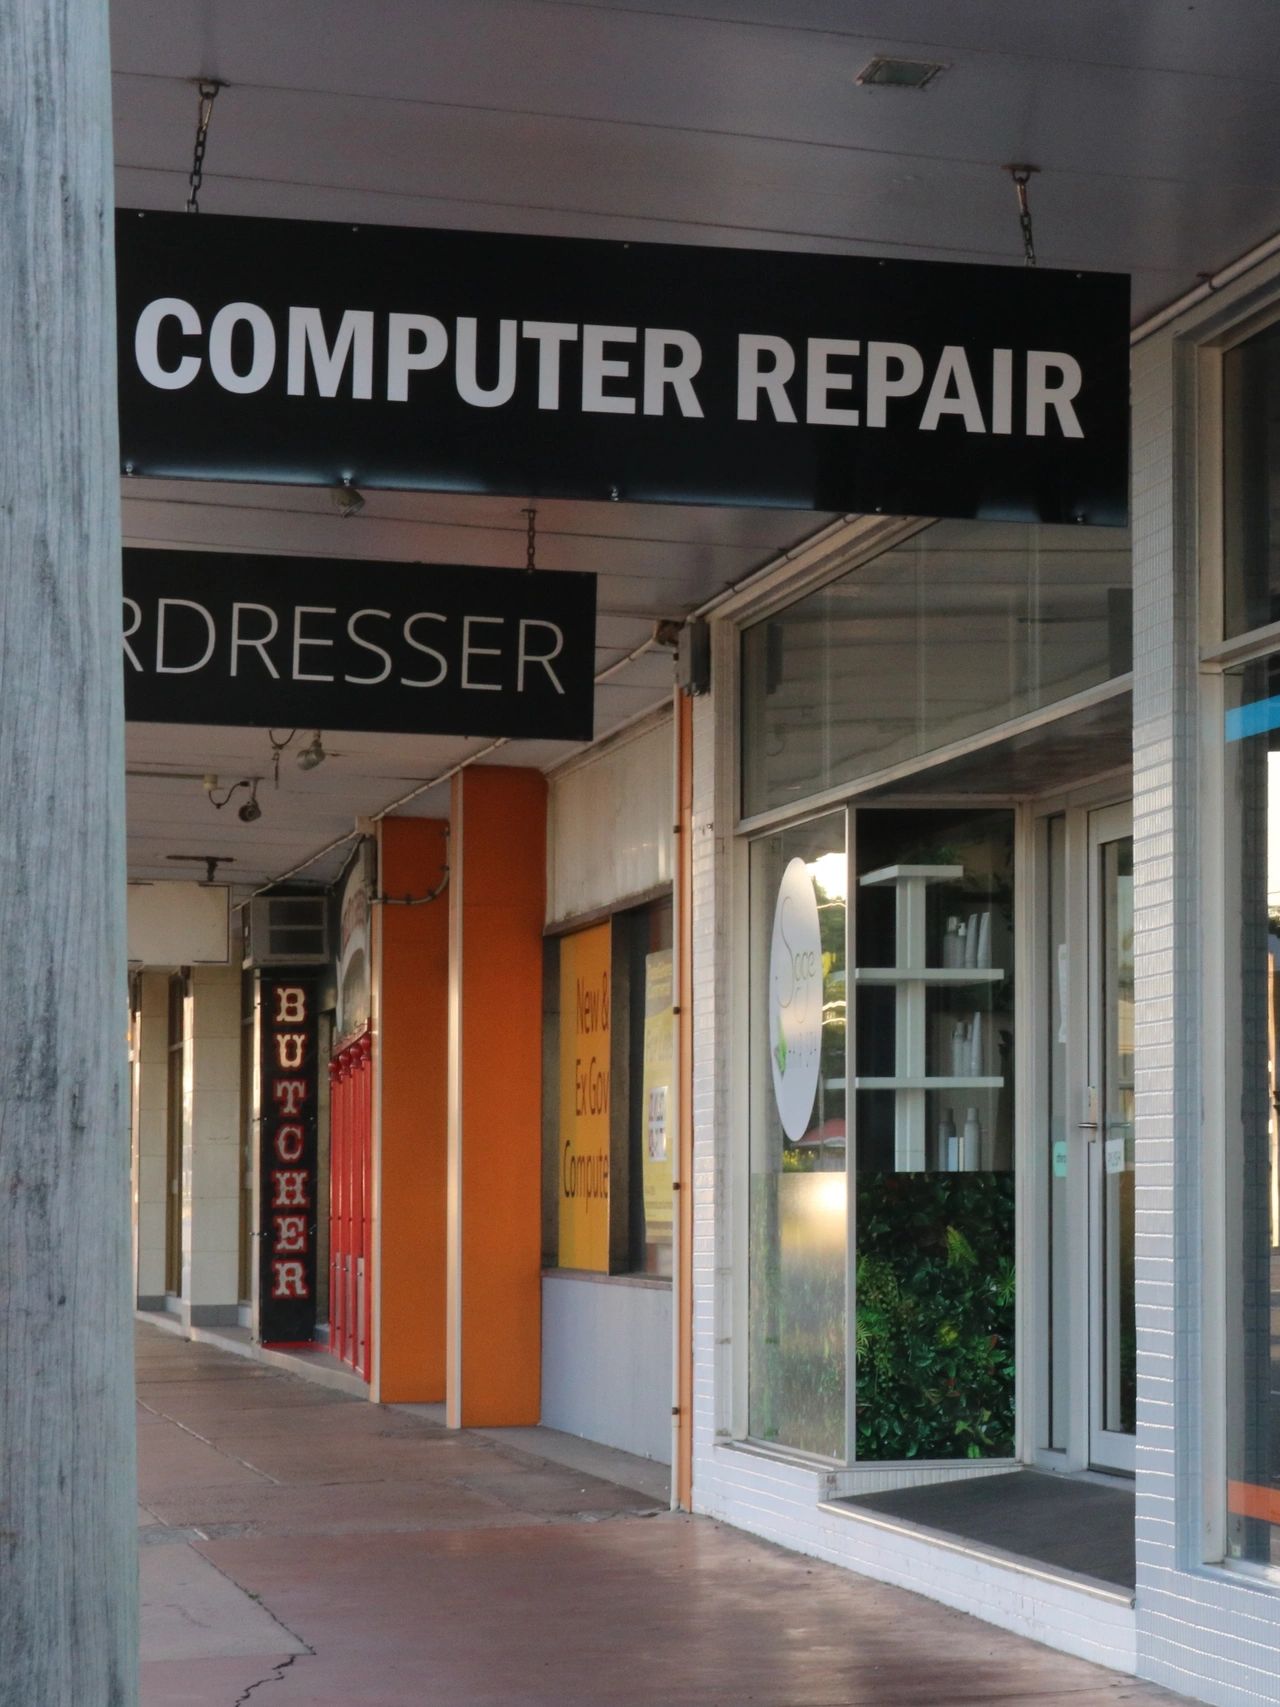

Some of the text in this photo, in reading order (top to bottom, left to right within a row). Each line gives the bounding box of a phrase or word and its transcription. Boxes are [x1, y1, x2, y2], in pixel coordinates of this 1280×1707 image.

[134, 297, 1085, 439] COMPUTER REPAIR
[576, 977, 600, 1034] New
[575, 1058, 587, 1117] Ex
[273, 986, 308, 1297] BUTCHER
